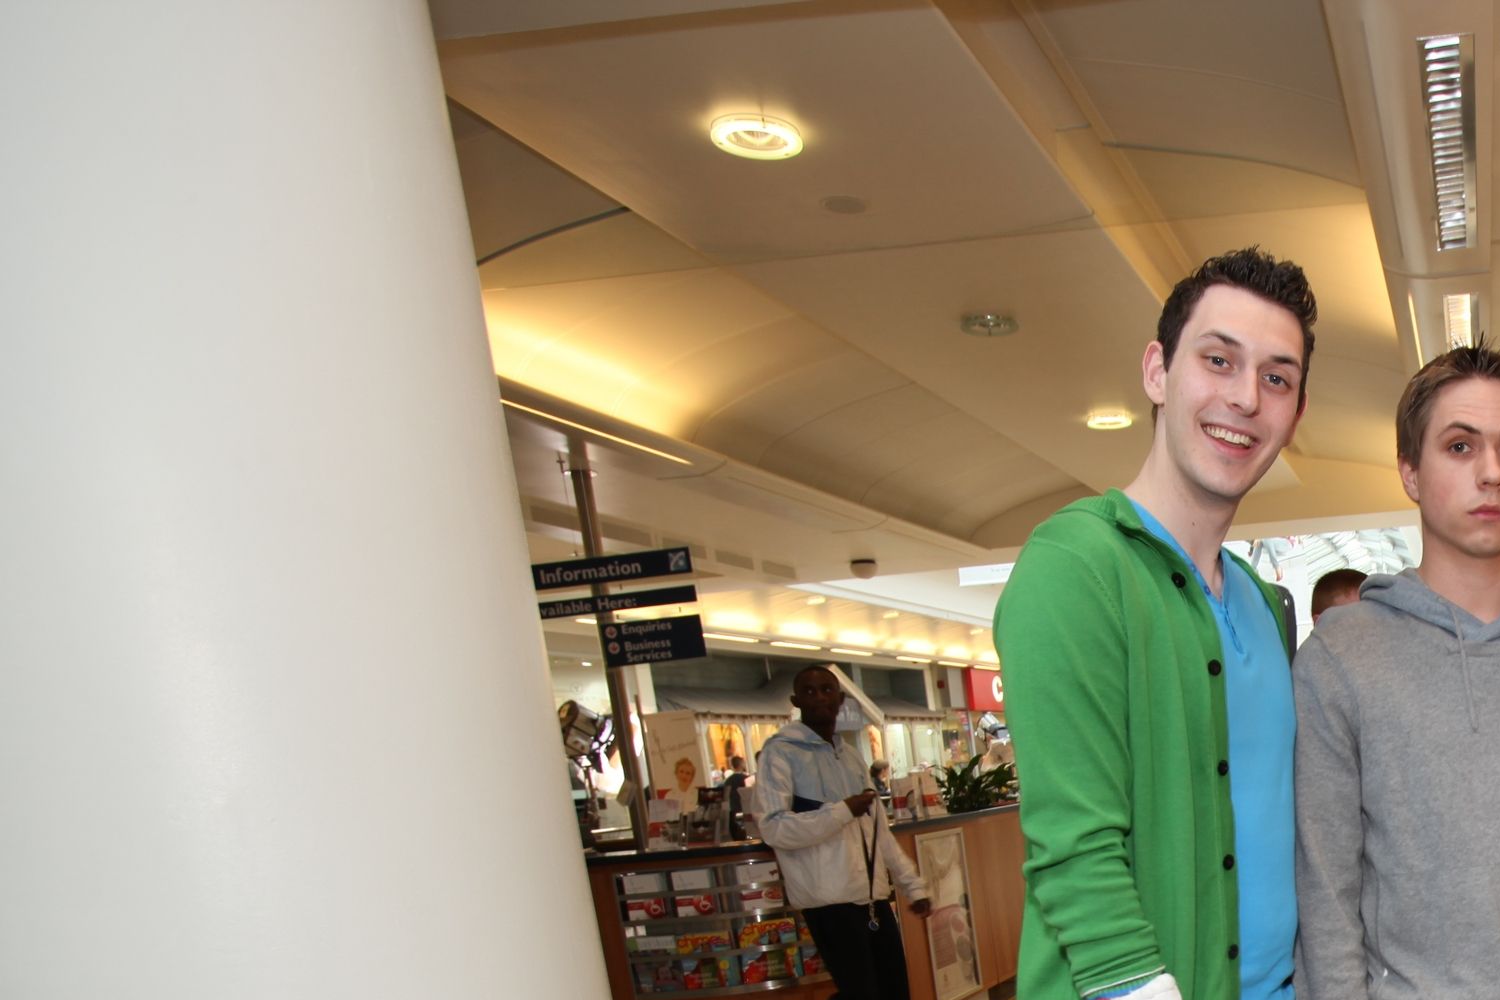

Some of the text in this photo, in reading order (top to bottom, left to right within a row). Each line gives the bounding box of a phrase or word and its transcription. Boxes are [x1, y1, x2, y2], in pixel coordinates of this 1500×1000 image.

[539, 561, 642, 584] Information
[540, 597, 638, 617] vailable Here:
[621, 621, 673, 635] Enquiries
[624, 638, 672, 652] Business
[626, 650, 673, 663] Services
